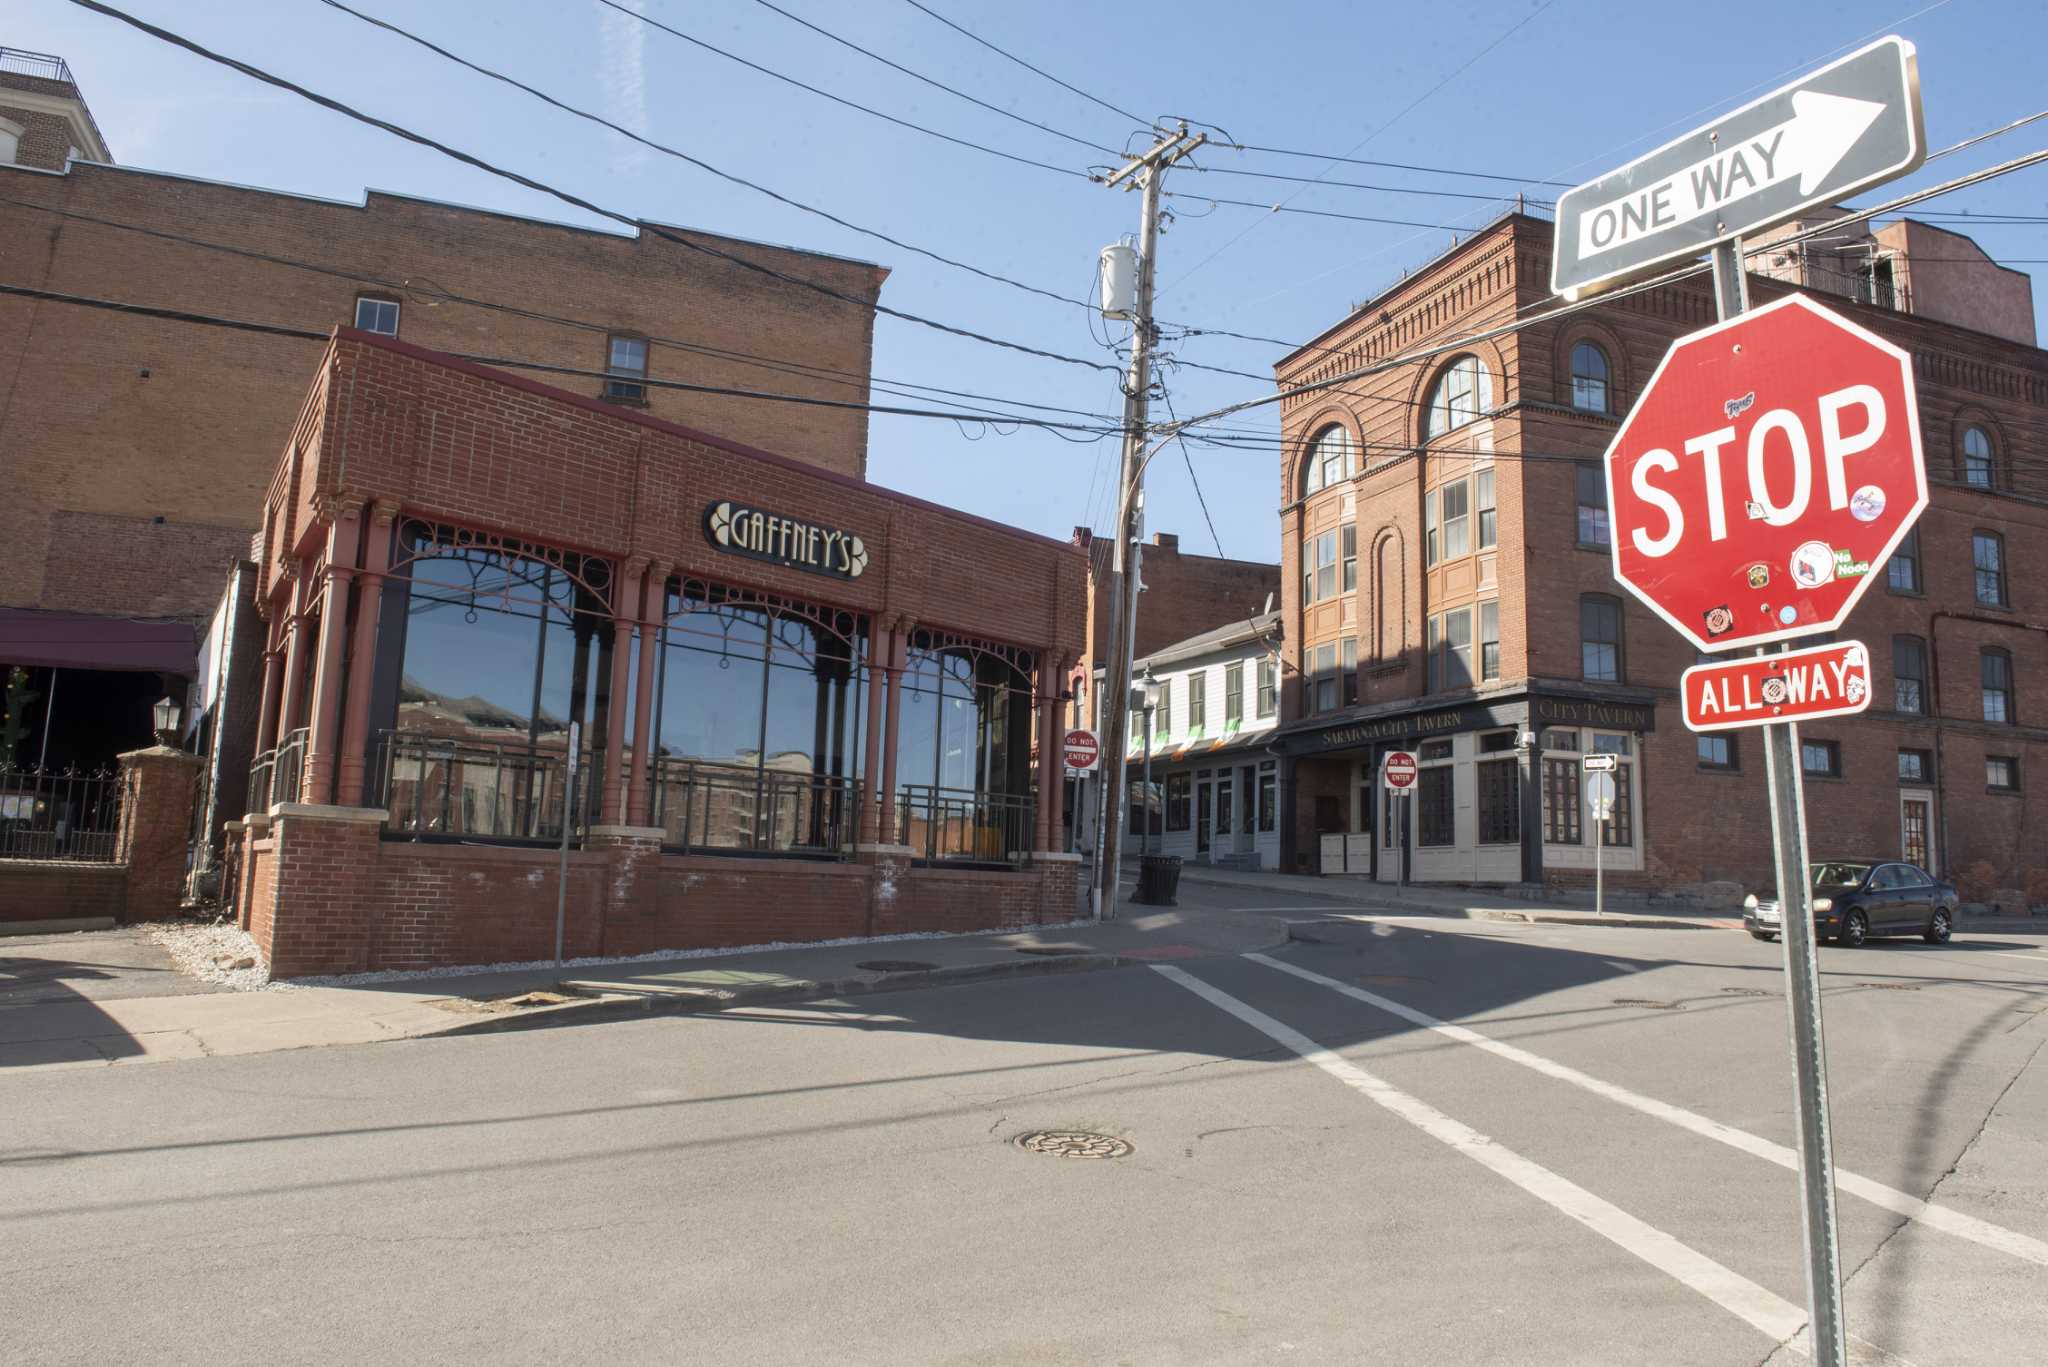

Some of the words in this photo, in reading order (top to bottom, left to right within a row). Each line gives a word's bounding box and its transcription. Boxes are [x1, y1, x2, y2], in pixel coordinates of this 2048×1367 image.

[1590, 182, 1677, 249] ONE
[1689, 130, 1785, 210] WAY
[1631, 384, 1888, 559] STOP
[730, 509, 851, 572] GAFFNEY'S
[1700, 675, 1763, 716] ALL
[1783, 660, 1848, 705] WAY
[1415, 711, 1463, 731] TAVERN
[1539, 700, 1577, 720] CITY
[1583, 703, 1646, 725] TAVERN
[1066, 737, 1077, 745] DO
[1068, 753, 1090, 761] ENTER
